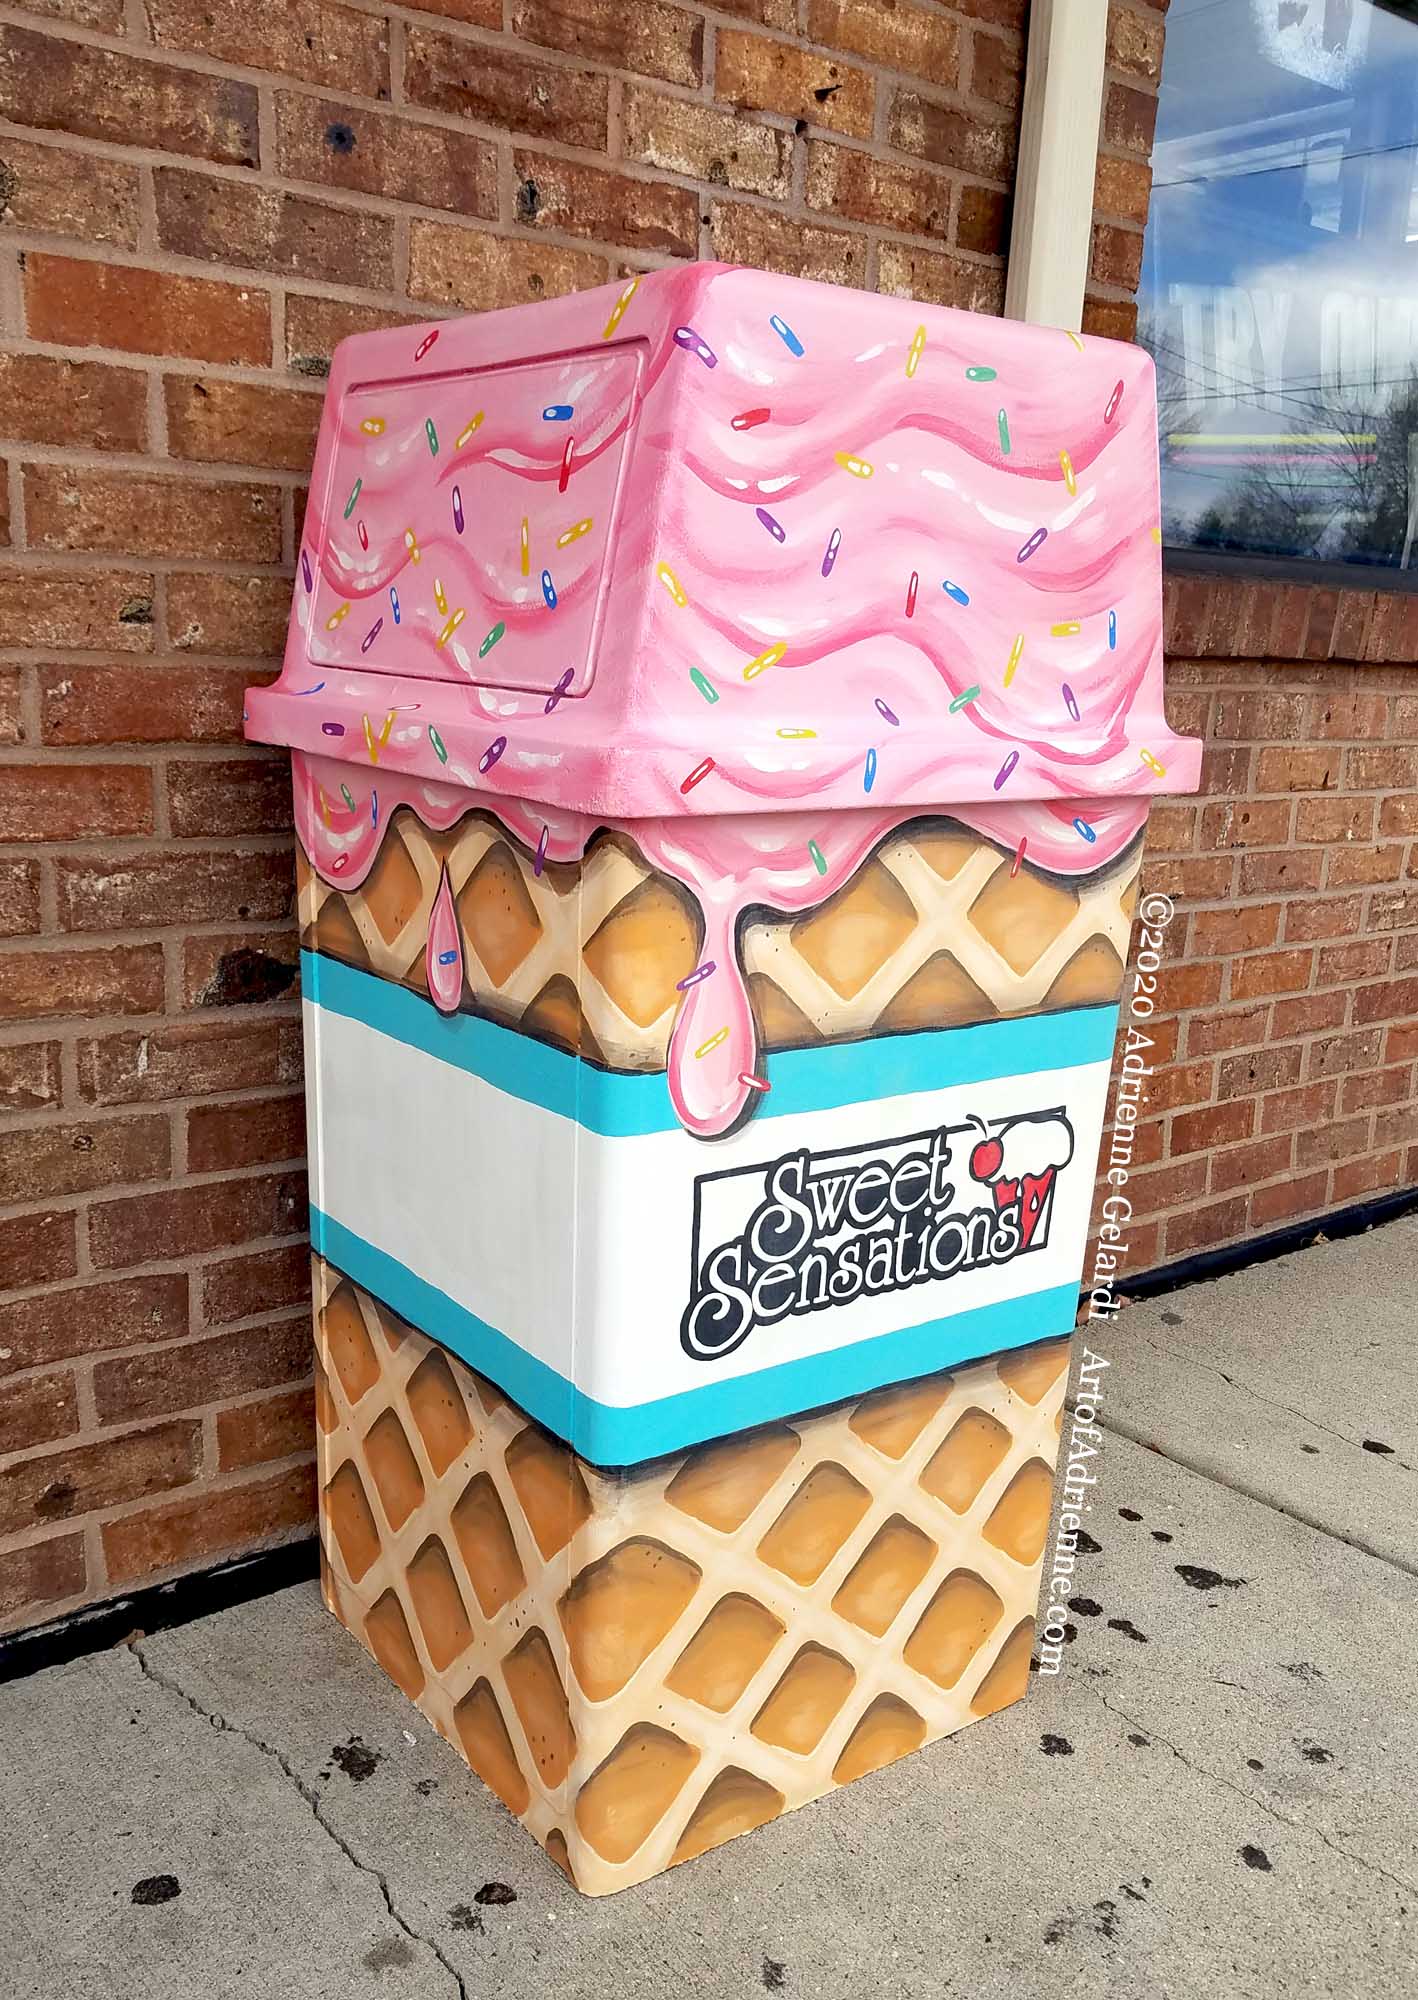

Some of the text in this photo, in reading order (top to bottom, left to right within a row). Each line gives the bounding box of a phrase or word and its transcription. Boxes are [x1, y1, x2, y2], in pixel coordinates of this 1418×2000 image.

[1169, 284, 1293, 409] TRY
[749, 1131, 952, 1264] Sweet
[686, 1204, 1020, 1356] Sensations
